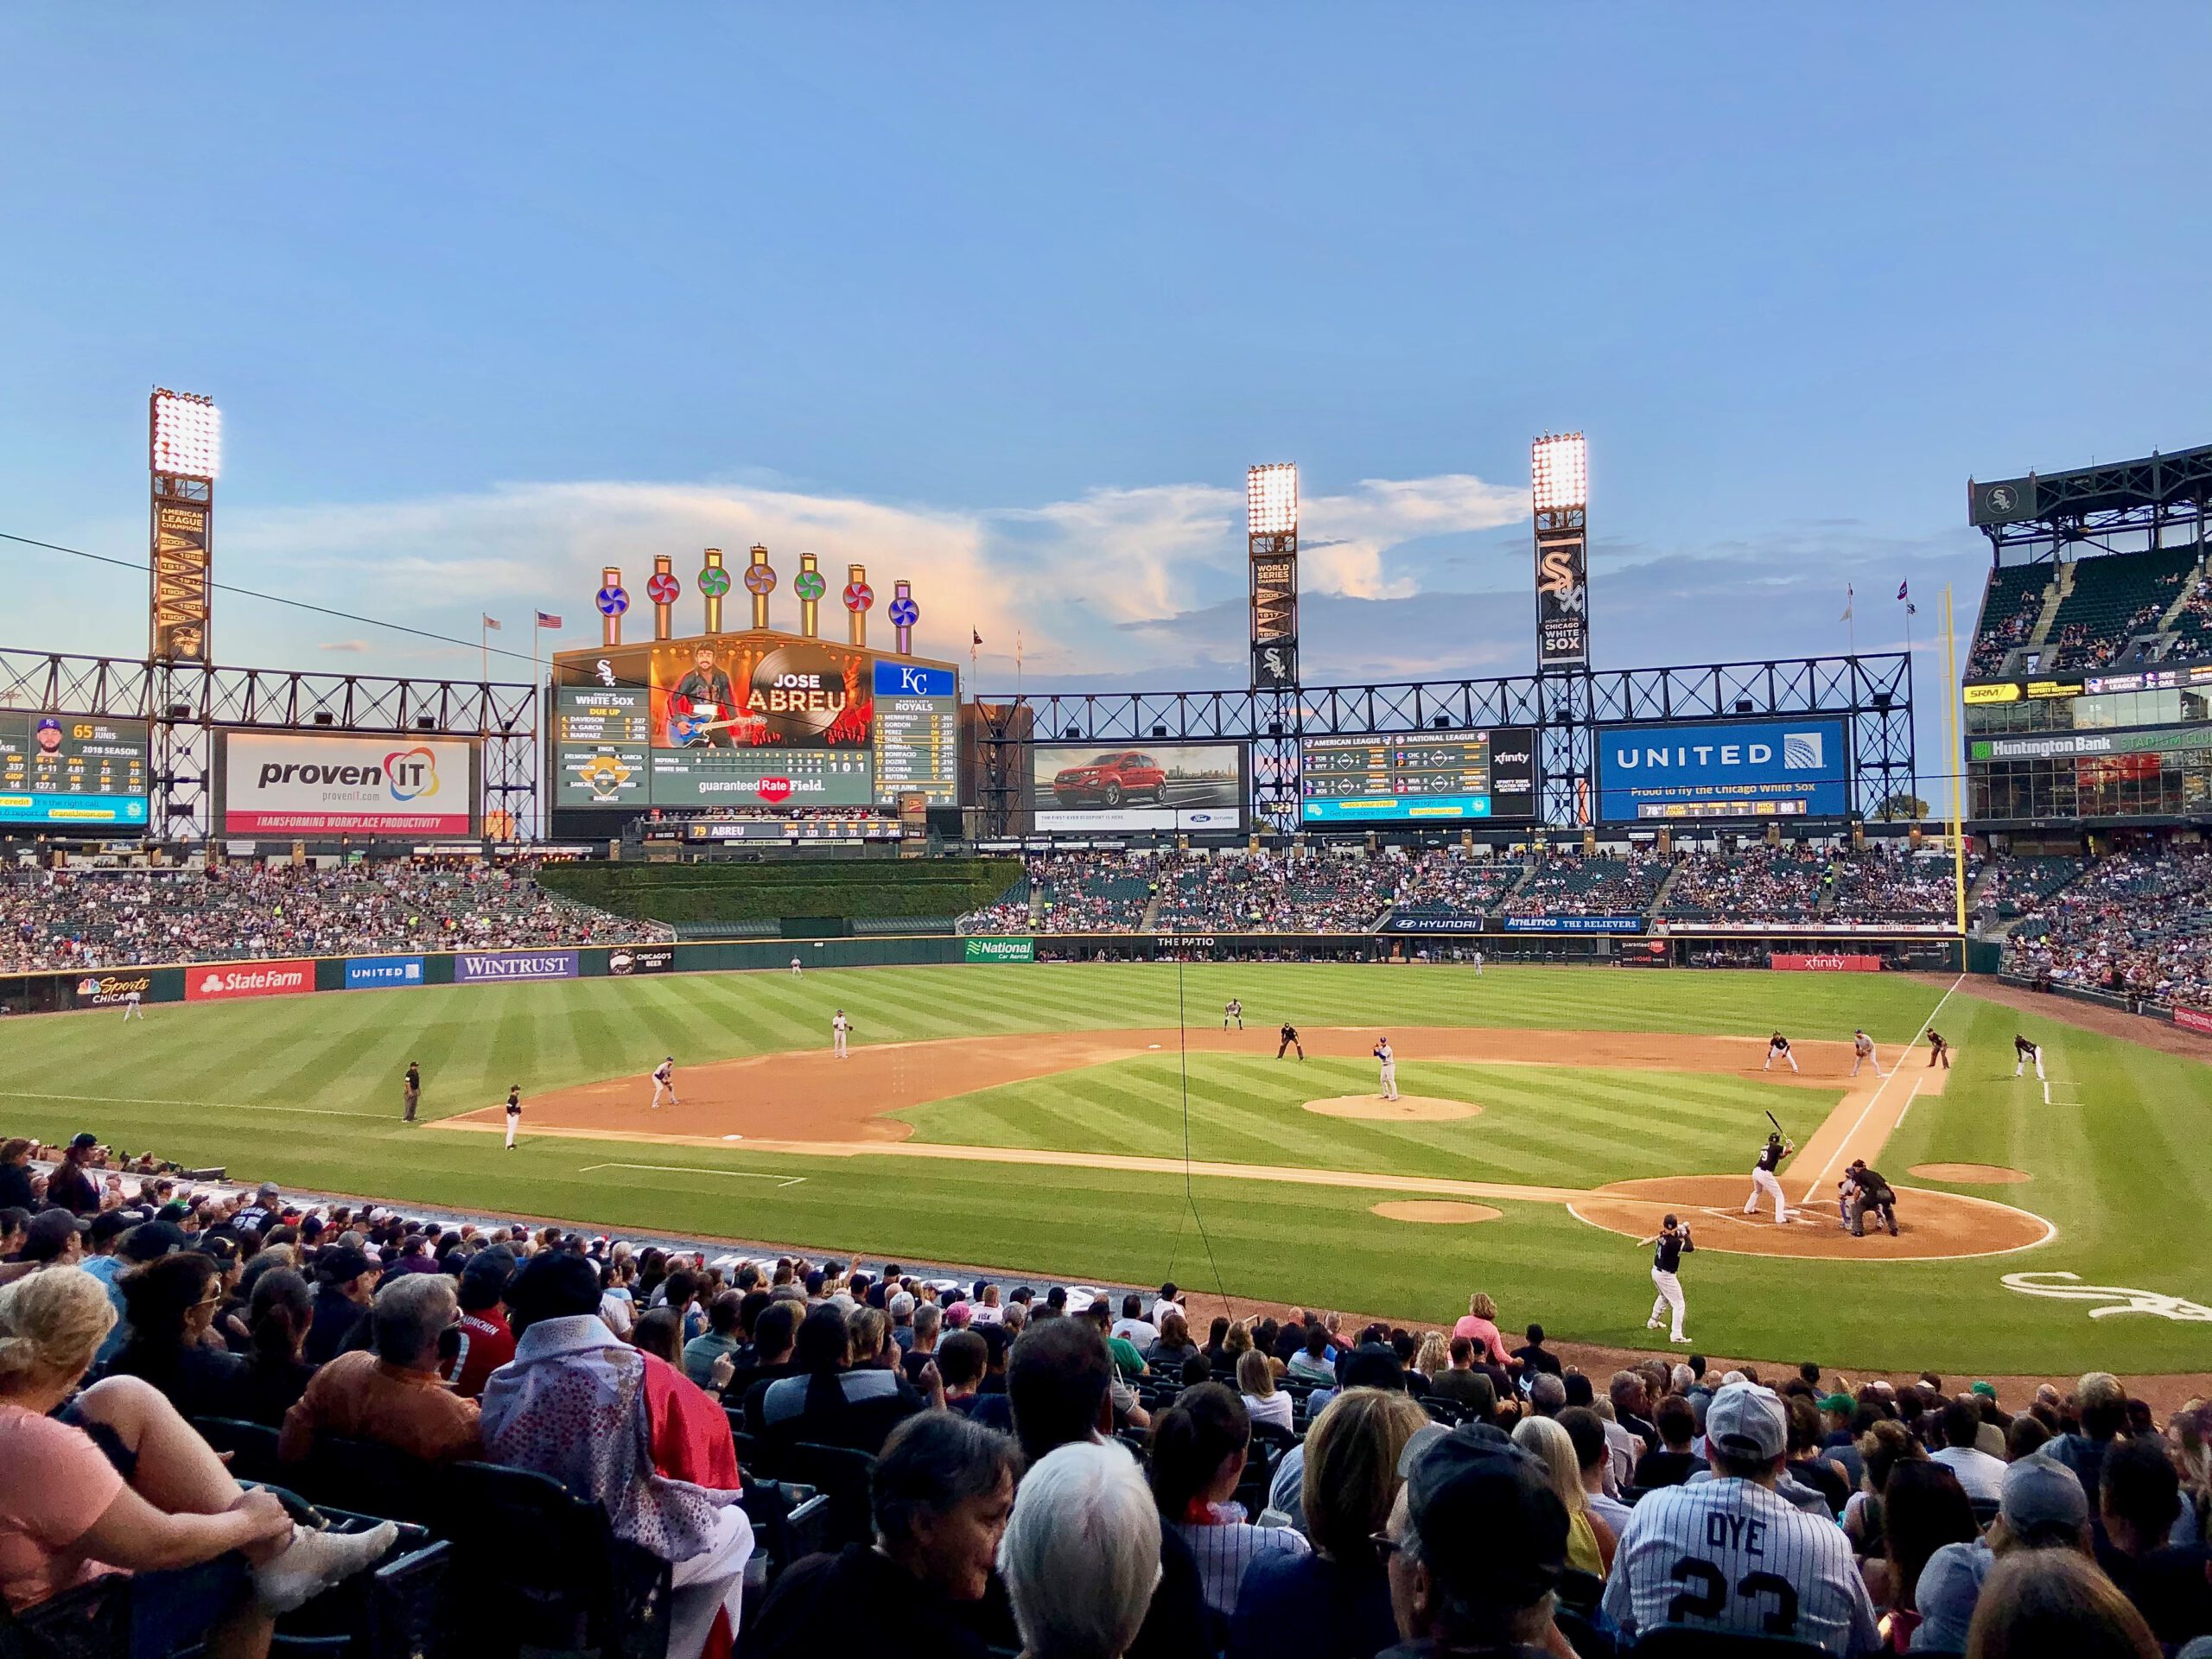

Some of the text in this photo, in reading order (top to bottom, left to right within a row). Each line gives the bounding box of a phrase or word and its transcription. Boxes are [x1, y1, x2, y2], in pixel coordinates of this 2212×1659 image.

[162, 508, 203, 523] AMERICAN
[162, 515, 203, 526] LEAGUE
[162, 523, 203, 532] CHAMPIONS
[1257, 571, 1289, 580] SERIES
[1545, 622, 1579, 631] CHICAGO
[1545, 629, 1580, 639] WHITE
[1545, 639, 1580, 652] SOX
[772, 674, 820, 689] JOSE
[900, 667, 927, 695] KC
[2105, 676, 2142, 684] AMERICAN
[1970, 690, 1999, 698] SRM
[575, 696, 634, 706] WHITE SOX
[745, 689, 847, 712] ABREU
[895, 703, 933, 712] ROYALS
[73, 724, 92, 739] 65
[1313, 738, 1351, 747] AMERICAN
[1407, 734, 1442, 743] NATIONAL
[2120, 735, 2181, 749] STADIUM
[104, 747, 138, 755] SEASON
[1993, 737, 2111, 757] Huntington Bank
[1494, 753, 1529, 765] xfinity
[1617, 744, 1773, 769] UNITED
[830, 762, 864, 772] 1 0 1
[257, 762, 425, 788] proven IT
[35, 781, 57, 790] 127.1
[698, 779, 826, 793] guaranteed Rate Field.
[1631, 786, 1662, 797] Proud
[1678, 786, 1692, 797] fly
[1695, 785, 1713, 795] the
[1715, 785, 1756, 797] Chicago
[1759, 784, 1792, 792] White
[1795, 783, 1815, 791] Sox
[322, 791, 380, 802] provenIT.com
[65, 800, 83, 809] right
[1780, 802, 1794, 812] 80
[257, 816, 442, 829] TRANSFORMING WORKPLACE PRODUCTIVITY
[693, 826, 707, 836] 79
[710, 826, 745, 836] ABREU
[1508, 918, 1557, 927] ATHLETICO
[1158, 938, 1215, 946] THE PATIO
[982, 942, 1032, 954] National
[636, 952, 672, 961] CHICAGO'S
[464, 956, 570, 976] WINTRUST
[1804, 957, 1845, 970] xfinity
[352, 968, 403, 978] UNITED
[100, 976, 150, 994] Sports
[226, 971, 302, 992] State Farm
[92, 992, 129, 1004] CHICA
[1707, 1511, 1767, 1556] DYE
[1668, 1555, 1799, 1637] 23
